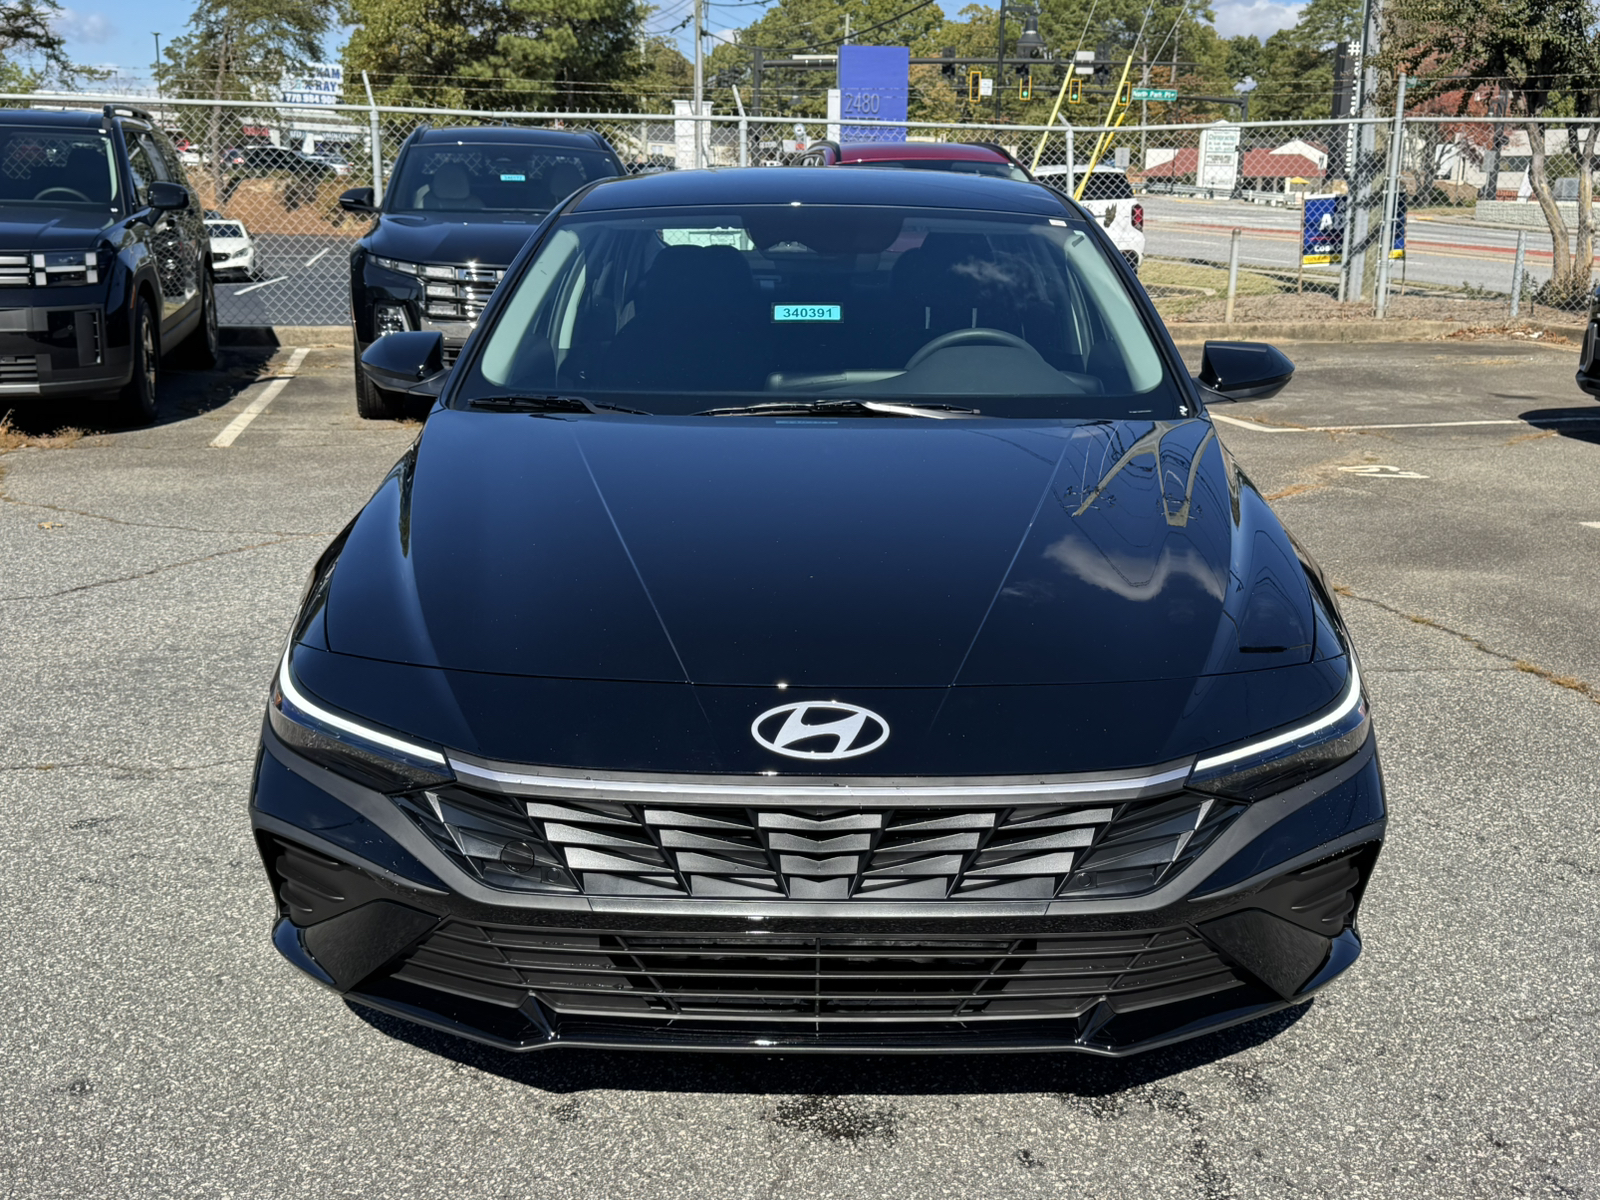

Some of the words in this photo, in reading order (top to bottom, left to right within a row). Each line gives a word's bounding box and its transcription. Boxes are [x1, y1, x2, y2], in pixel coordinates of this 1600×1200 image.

[1149, 90, 1162, 98] Park
[845, 93, 880, 115] 2480
[783, 303, 832, 317] 340391
